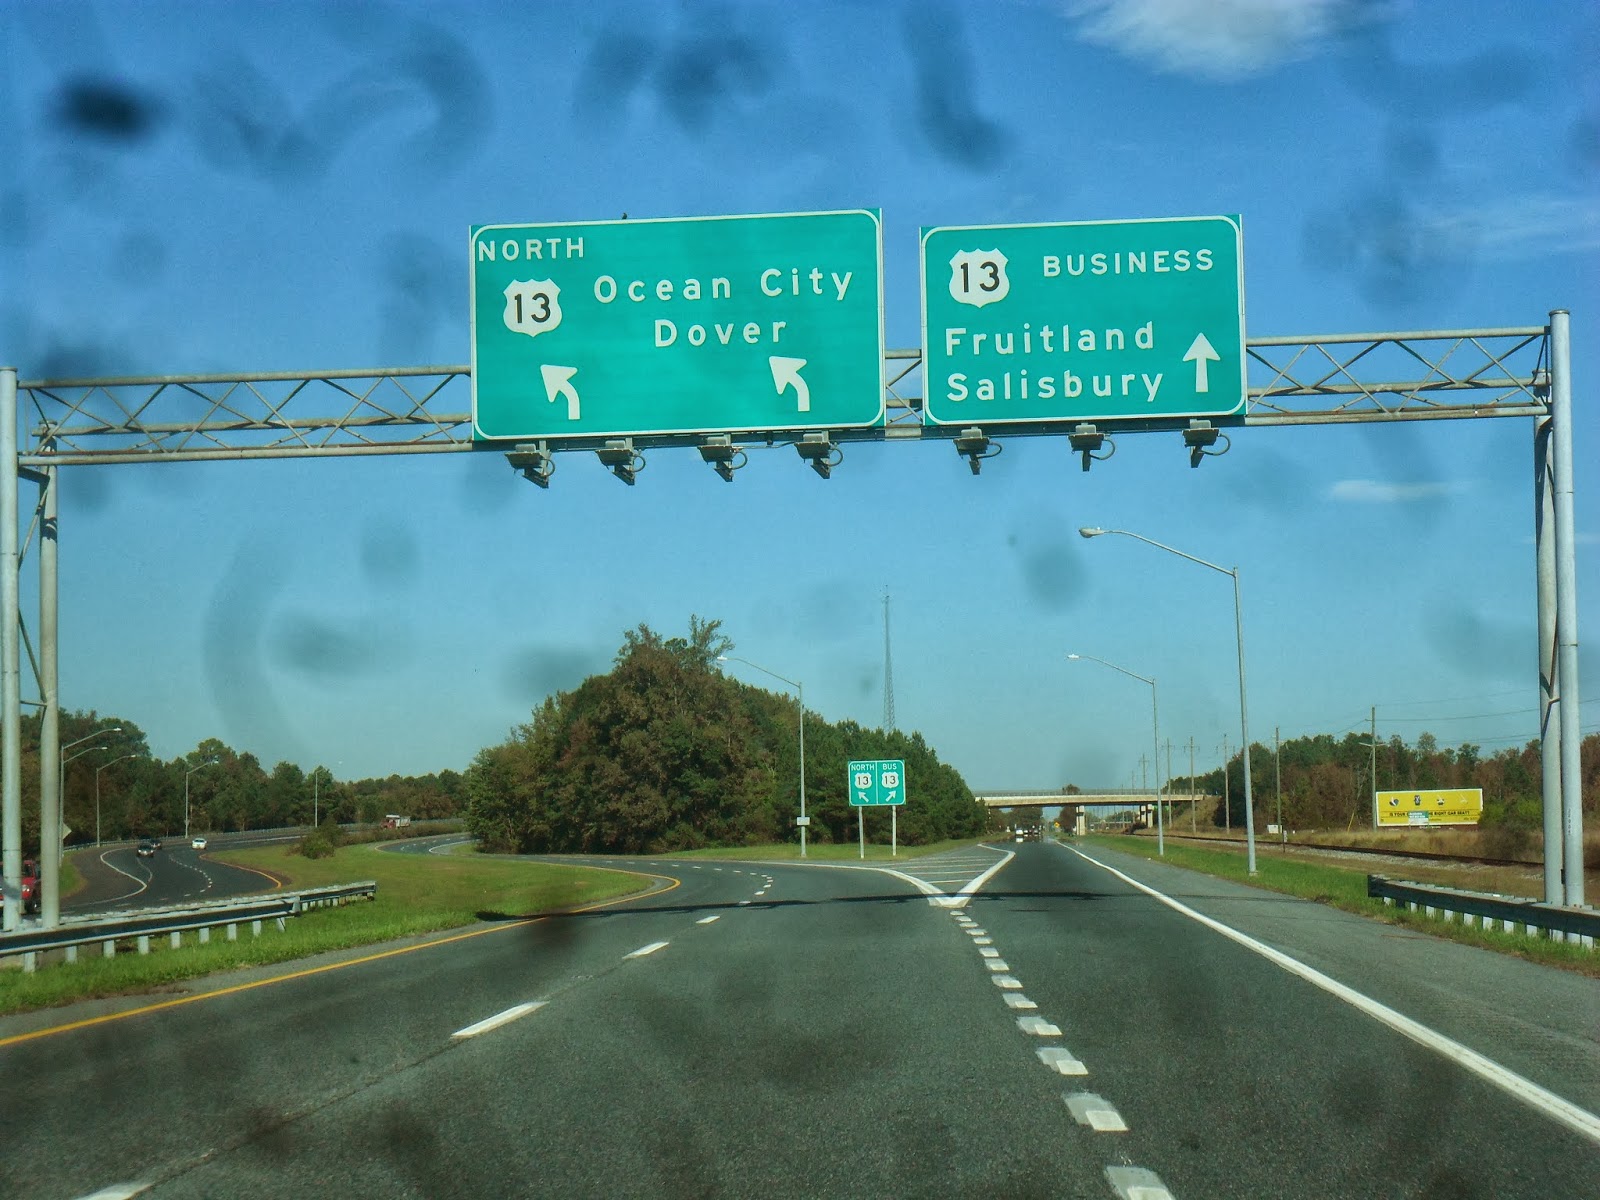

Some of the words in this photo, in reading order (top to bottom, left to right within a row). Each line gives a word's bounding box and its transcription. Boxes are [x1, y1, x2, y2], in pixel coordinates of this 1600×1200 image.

[478, 237, 584, 262] NORTH
[1043, 249, 1214, 277] BUSINESS
[594, 275, 731, 303] Ocean
[761, 267, 853, 301] City
[961, 261, 1000, 293] 13
[513, 292, 551, 324] 13
[654, 318, 787, 347] Dover
[945, 321, 1154, 356] Fruitland
[946, 369, 1163, 402] Salisbury
[851, 763, 875, 771] NORTH
[857, 776, 869, 786] 13
[884, 775, 896, 785] 13
